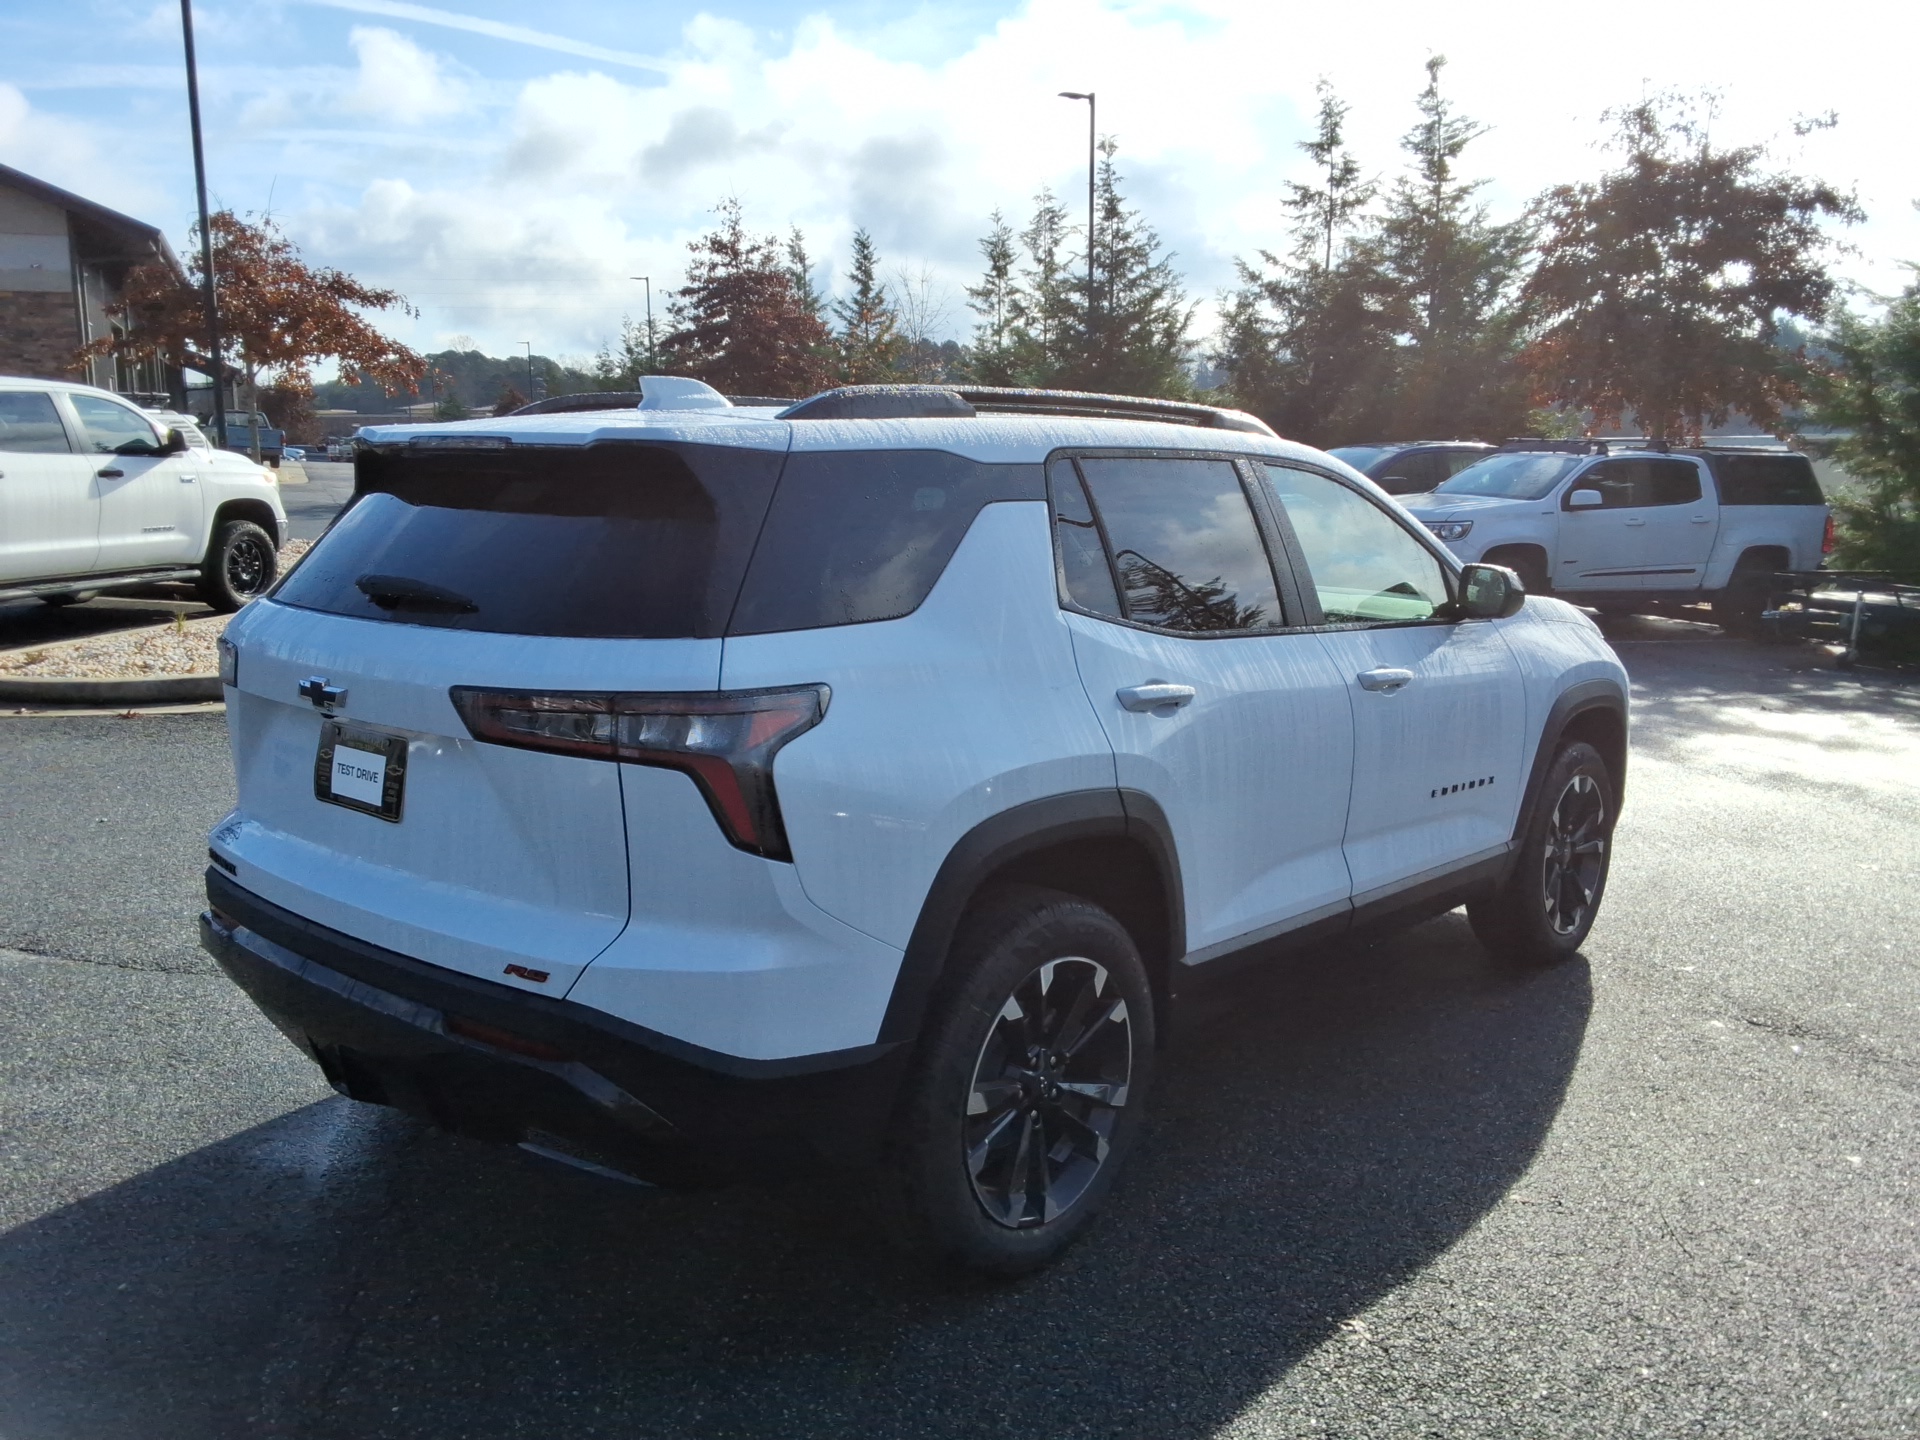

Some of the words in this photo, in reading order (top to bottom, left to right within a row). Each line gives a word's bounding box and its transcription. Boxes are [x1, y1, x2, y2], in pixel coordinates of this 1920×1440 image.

[337, 763, 355, 777] TEST
[356, 767, 379, 783] DRIVE
[503, 963, 551, 983] RS
